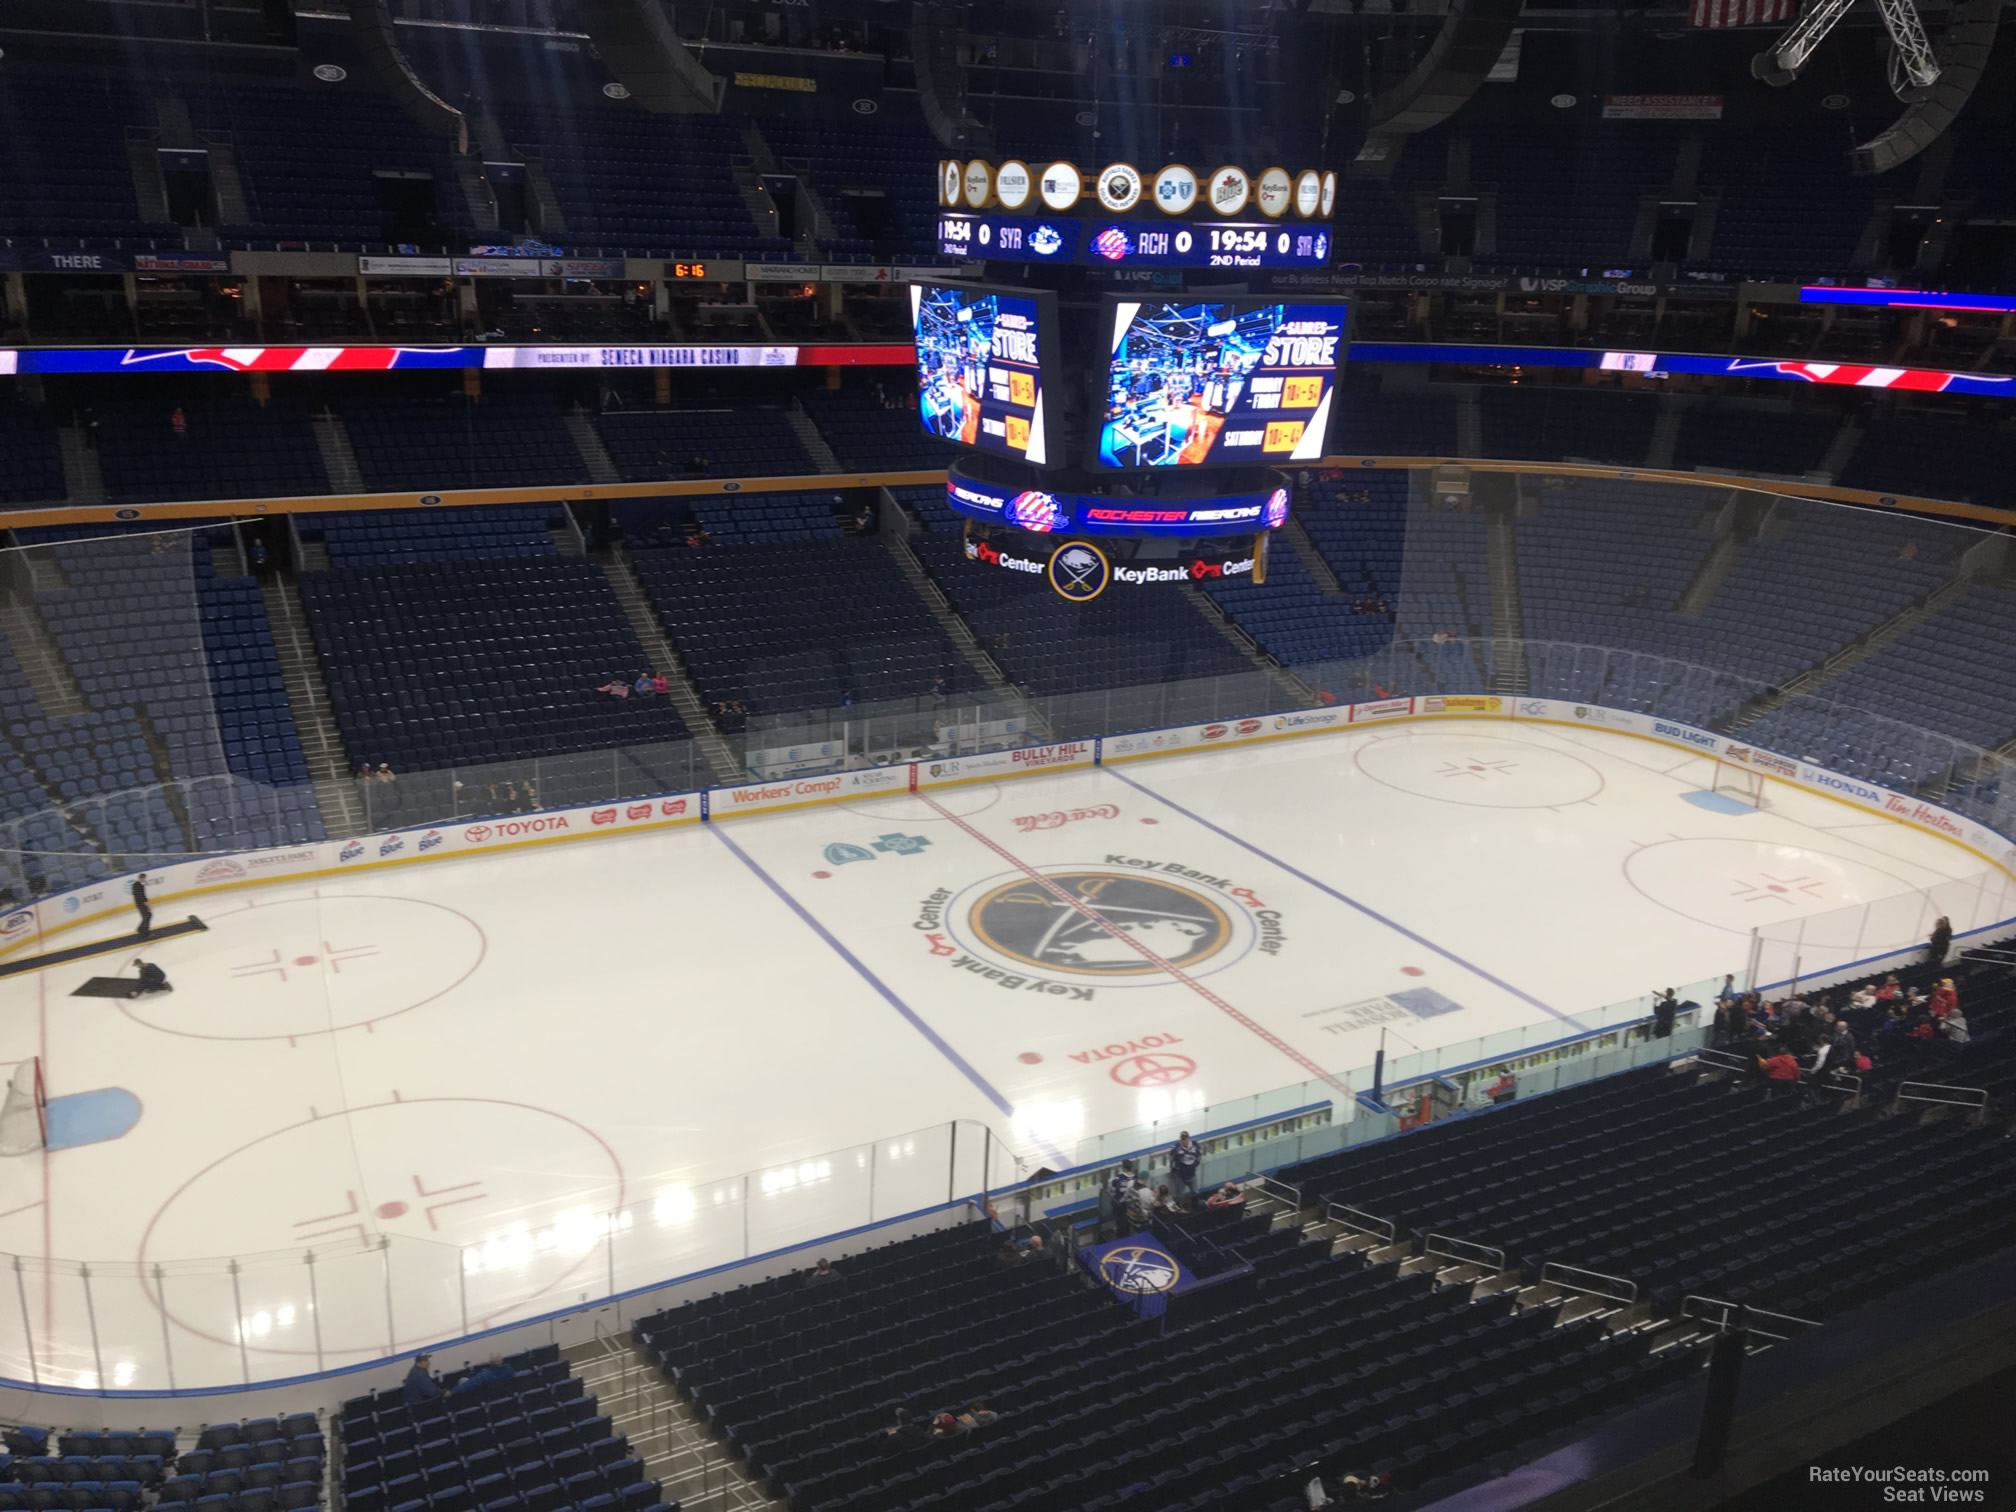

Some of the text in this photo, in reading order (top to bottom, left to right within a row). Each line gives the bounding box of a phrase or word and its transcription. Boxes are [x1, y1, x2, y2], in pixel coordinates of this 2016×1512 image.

[1000, 227, 1022, 249] SYR
[1138, 232, 1169, 255] RCH
[1175, 231, 1192, 253] 0
[1210, 230, 1267, 252] 19:54
[1278, 232, 1291, 254] 0
[52, 255, 102, 269] THERE
[673, 264, 705, 277] 6:16
[1209, 254, 1261, 266] 2ND Period
[1331, 274, 1358, 285] Need
[1378, 275, 1407, 287] Notch
[991, 326, 1038, 364] STORE
[1263, 336, 1339, 366] STORE
[601, 348, 740, 366] SENECA NIAGARA CASINO
[1087, 508, 1188, 521] ROCHESTER
[1188, 505, 1262, 521] AMERICANS
[999, 553, 1045, 574] Center
[1113, 558, 1256, 585] KeyBank Center
[1654, 722, 1716, 749] BUD LIGHT
[1012, 742, 1088, 762] BULLY HILL
[1025, 754, 1075, 767] VINEYARDS
[731, 783, 794, 803] Workers'
[795, 777, 842, 794] Comp?
[1816, 773, 1881, 802] HONDA
[1884, 792, 1964, 837] Tim Hortons
[496, 816, 568, 837] TOYOTA
[912, 887, 954, 931] Center
[1255, 910, 1288, 956] Center
[1067, 1032, 1184, 1064] TOYOTA
